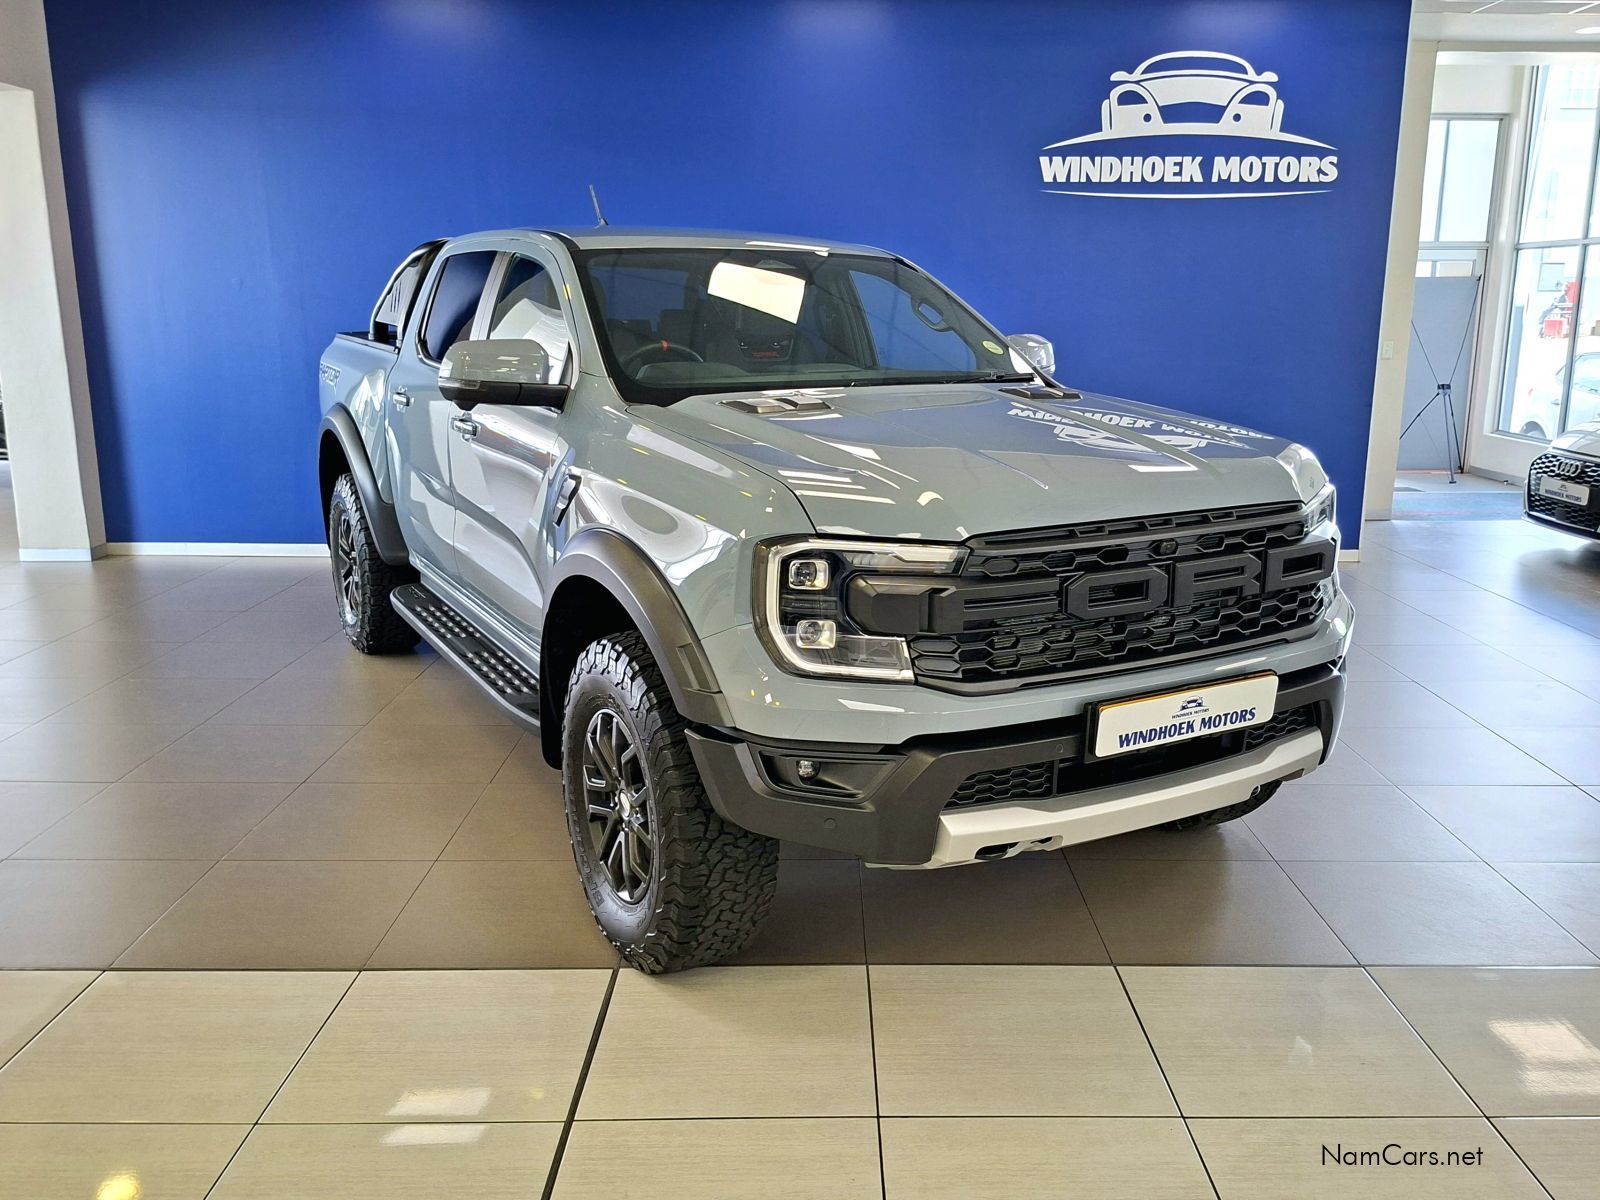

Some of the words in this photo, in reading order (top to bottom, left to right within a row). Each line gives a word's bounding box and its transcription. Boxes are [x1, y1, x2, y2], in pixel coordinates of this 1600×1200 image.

[1039, 156, 1203, 183] WINDHOEK
[1211, 156, 1339, 183] MOTORS
[928, 540, 1337, 634] FORD
[1118, 720, 1195, 748] WINDHOEK
[1200, 708, 1256, 731] MOTORS
